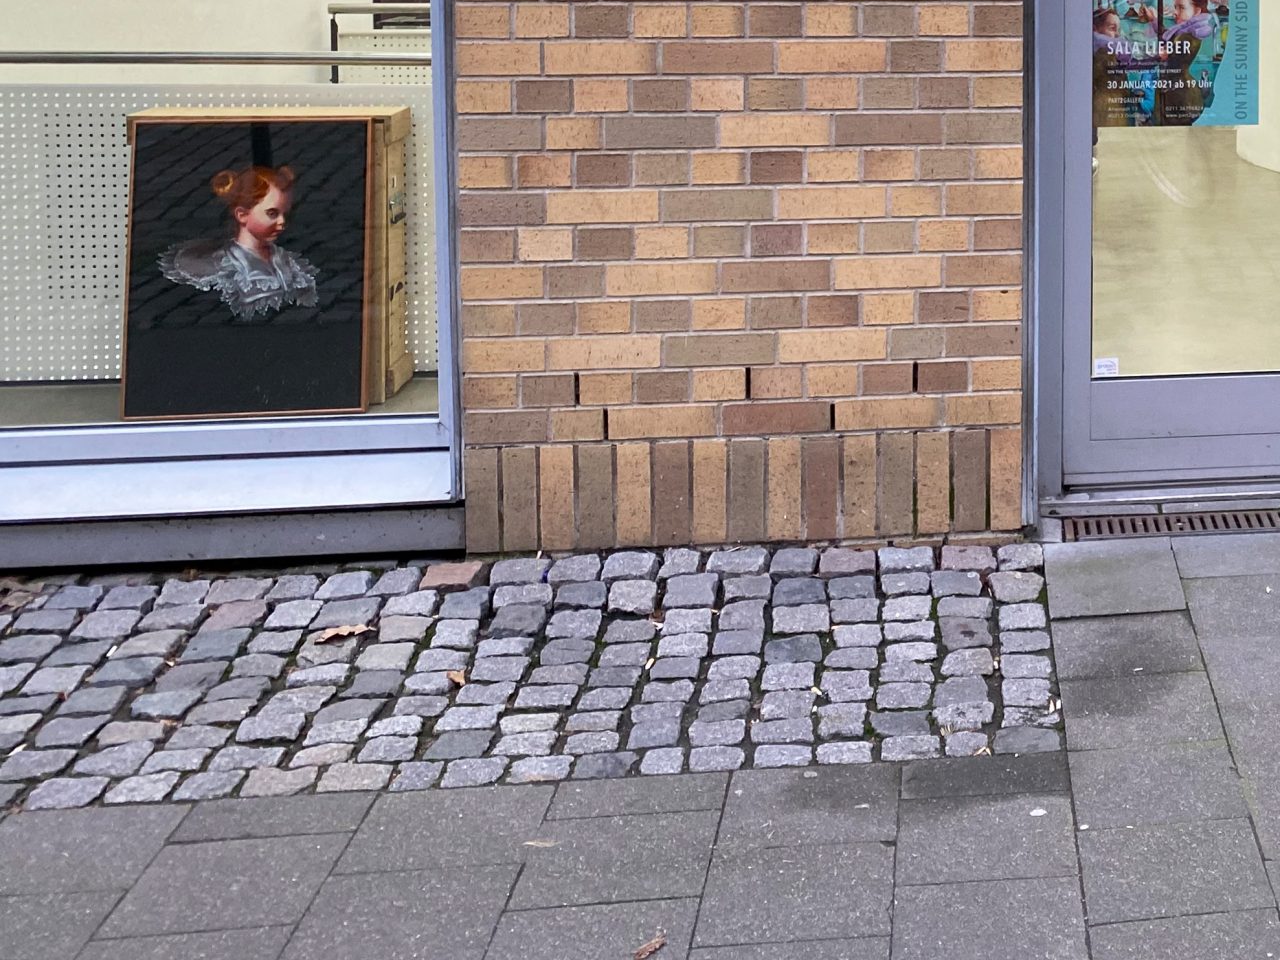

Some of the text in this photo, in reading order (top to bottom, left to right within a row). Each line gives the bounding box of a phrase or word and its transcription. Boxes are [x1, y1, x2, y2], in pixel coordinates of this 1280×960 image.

[1107, 41, 1191, 55] SALA LIEBER
[1235, 26, 1248, 70] SUNNY
[1107, 79, 1213, 89] 30 JANUAR 2021 ab 19 Uhr
[1235, 74, 1248, 98] THE
[1234, 101, 1248, 120] ON
